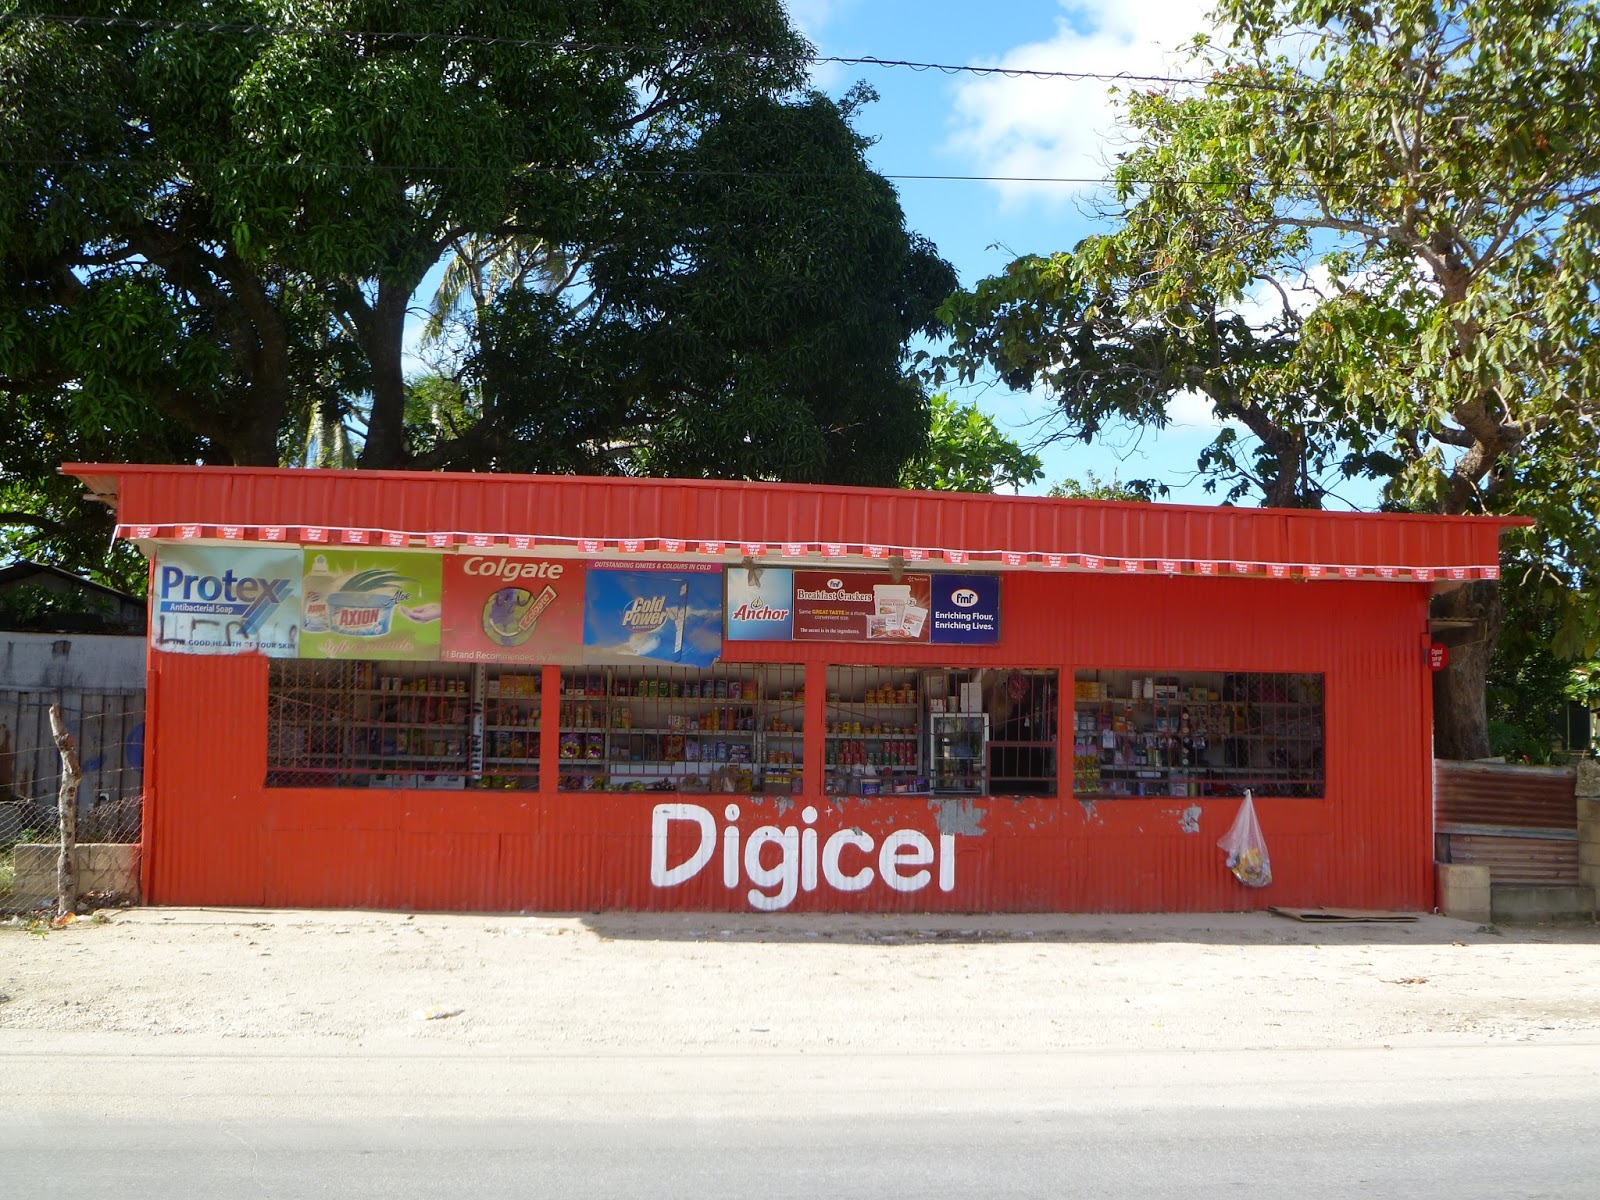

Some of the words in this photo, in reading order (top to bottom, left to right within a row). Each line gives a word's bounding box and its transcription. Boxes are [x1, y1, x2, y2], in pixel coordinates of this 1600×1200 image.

[463, 556, 564, 582] Colgate
[162, 566, 282, 604] Protex
[382, 590, 411, 606] Aloe
[797, 588, 837, 600] Breakfast
[838, 590, 872, 602] Crackers
[956, 592, 974, 604] fmf
[170, 602, 214, 612] Antibacterial
[216, 604, 234, 614] Soap
[308, 604, 326, 613] AXION
[524, 592, 551, 625] Colgate
[632, 595, 666, 613] Cold
[340, 608, 380, 626] AXION
[622, 610, 668, 626] Power
[733, 604, 789, 621] Anchor
[935, 612, 970, 623] Enriching
[972, 612, 994, 622] Flour,
[935, 622, 970, 633] Enriching
[972, 622, 994, 630] Lives.
[451, 650, 474, 659] Brand
[476, 652, 534, 661] Recommended
[650, 804, 955, 910] Digicel
